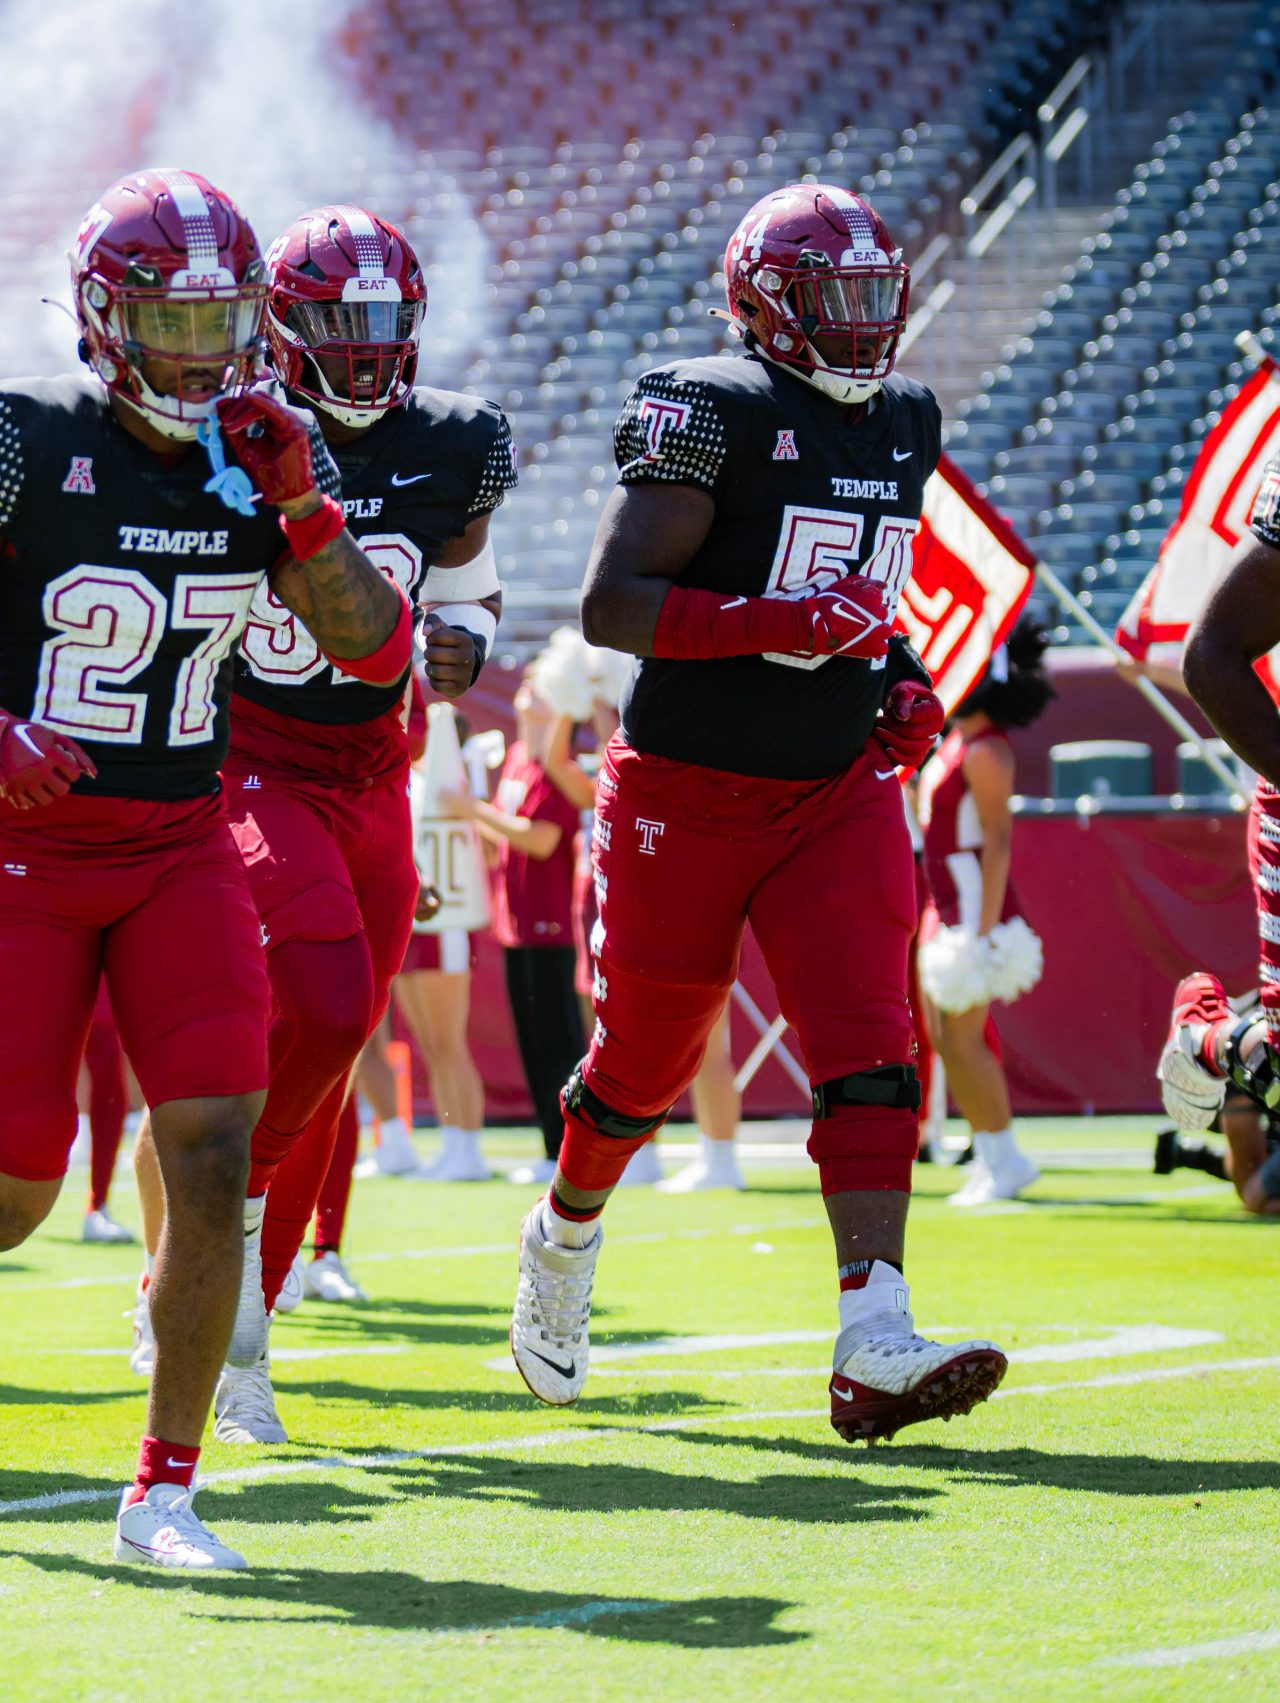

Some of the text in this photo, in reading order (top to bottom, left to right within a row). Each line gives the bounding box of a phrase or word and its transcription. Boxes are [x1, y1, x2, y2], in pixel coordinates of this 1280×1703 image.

[731, 213, 773, 261] 54
[853, 251, 880, 262] EAT
[186, 273, 221, 287] EAT
[358, 280, 388, 290] EAT
[831, 477, 899, 501] TEMPLE
[342, 497, 384, 519] PLE
[119, 525, 229, 555] TEMPLE
[30, 563, 266, 747] 27
[635, 817, 665, 855] T
